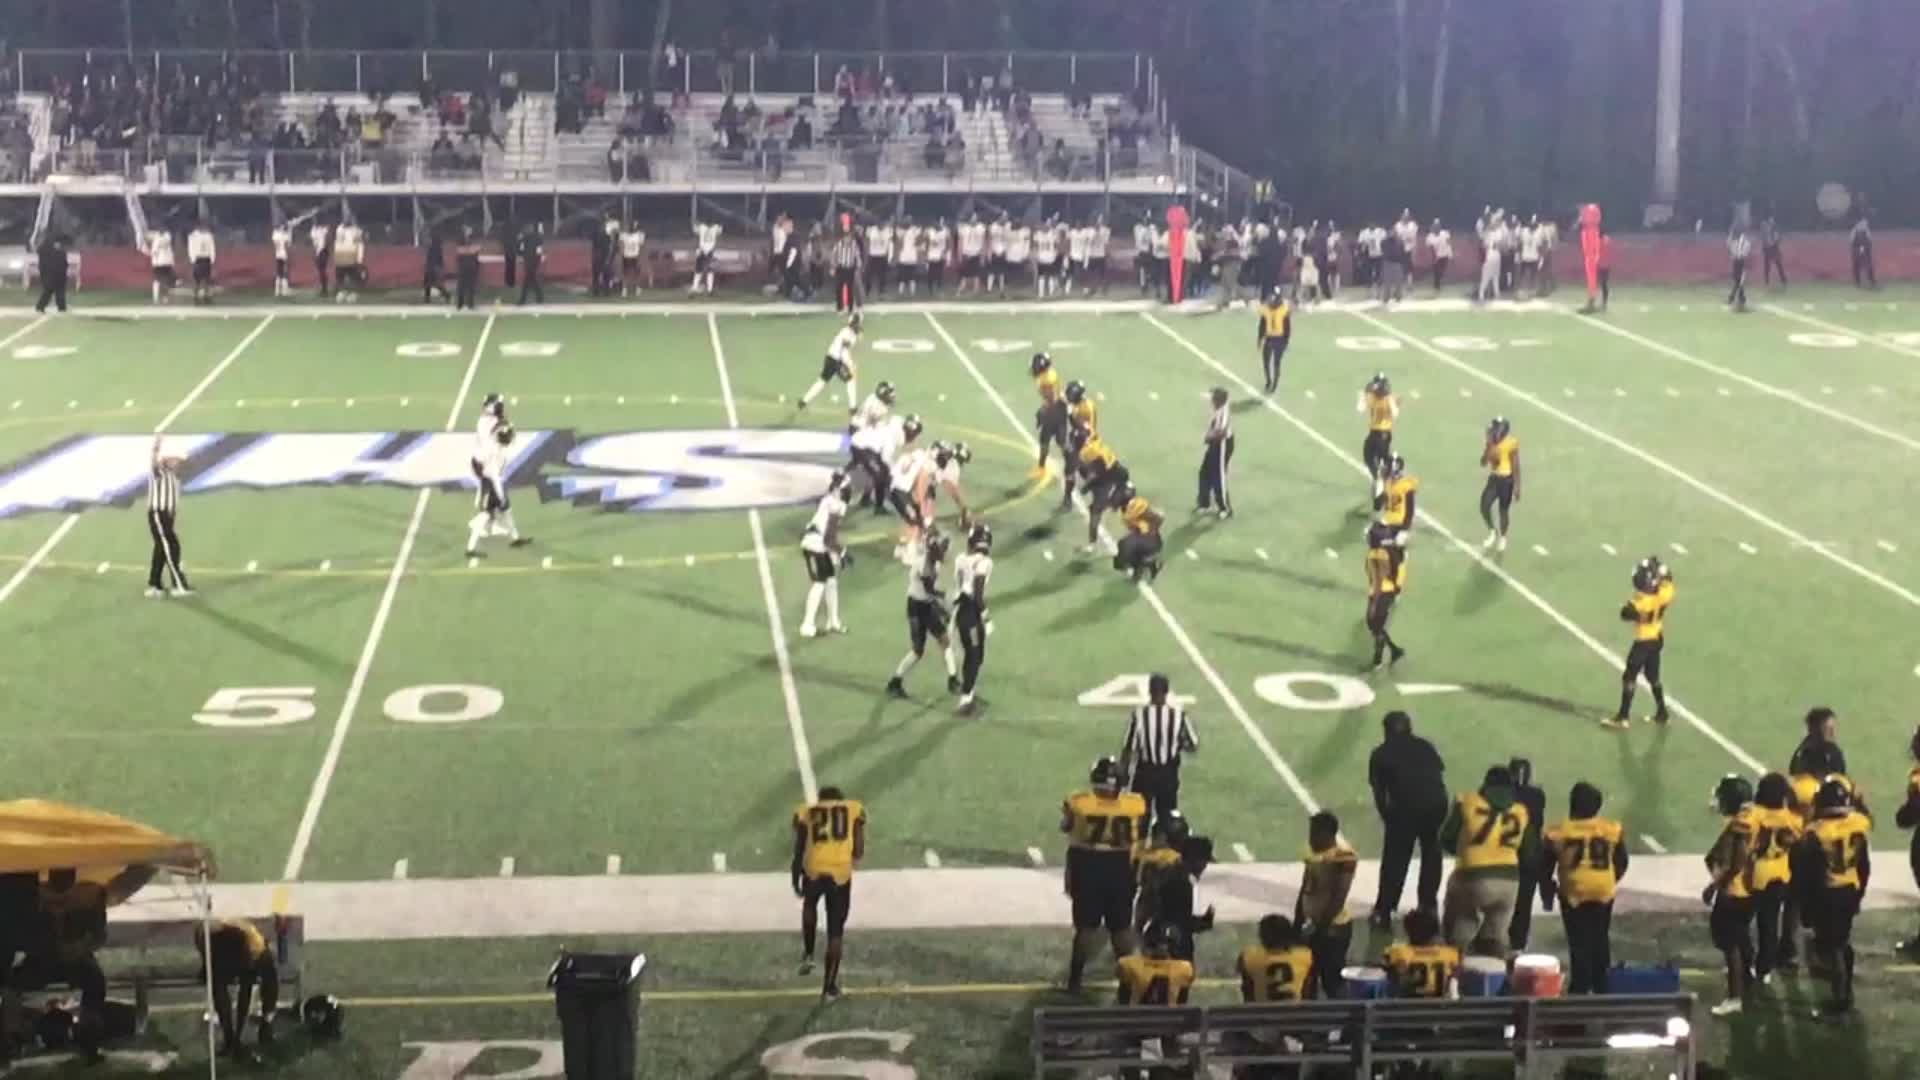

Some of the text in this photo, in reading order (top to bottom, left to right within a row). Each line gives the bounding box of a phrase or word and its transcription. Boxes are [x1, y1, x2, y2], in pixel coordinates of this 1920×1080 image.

[809, 805, 849, 843] 20
[1475, 806, 1521, 850] 72
[1265, 962, 1296, 998] 2
